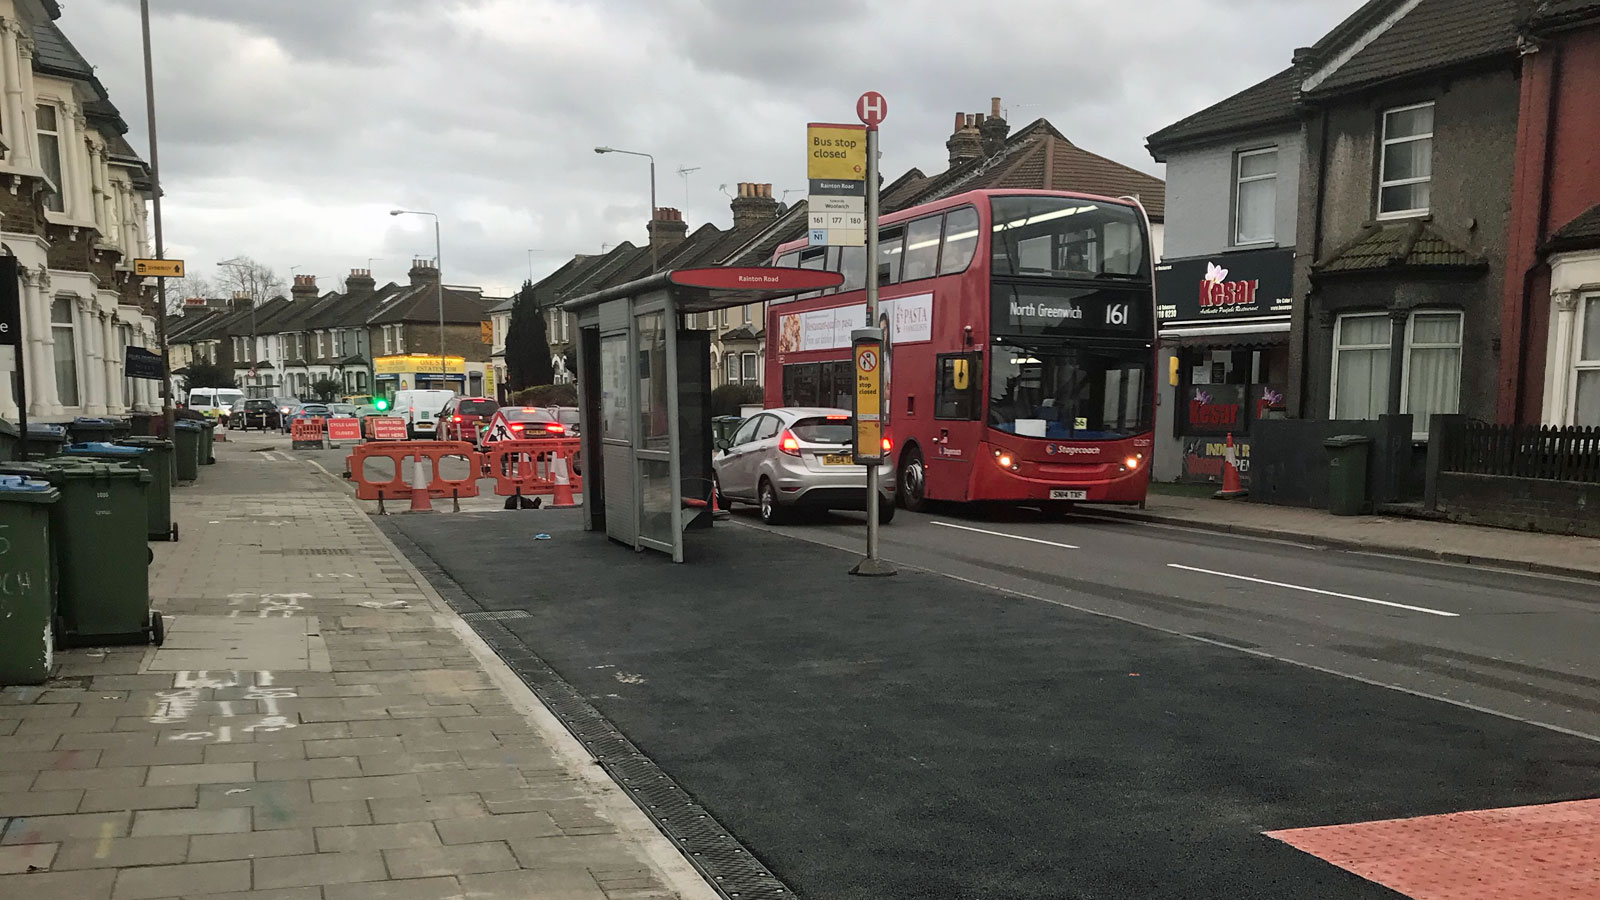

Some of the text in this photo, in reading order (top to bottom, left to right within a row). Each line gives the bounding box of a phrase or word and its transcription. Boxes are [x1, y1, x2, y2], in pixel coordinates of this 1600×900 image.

[863, 96, 882, 120] H
[814, 137, 856, 149] Bus stop
[814, 149, 846, 158] closed
[1200, 279, 1259, 307] Kesar
[904, 306, 927, 324] PASTA
[1010, 302, 1082, 319] North Greenwich
[1106, 304, 1128, 324] 161
[1190, 400, 1239, 423] Kesar
[1058, 446, 1100, 455] Stagecoach
